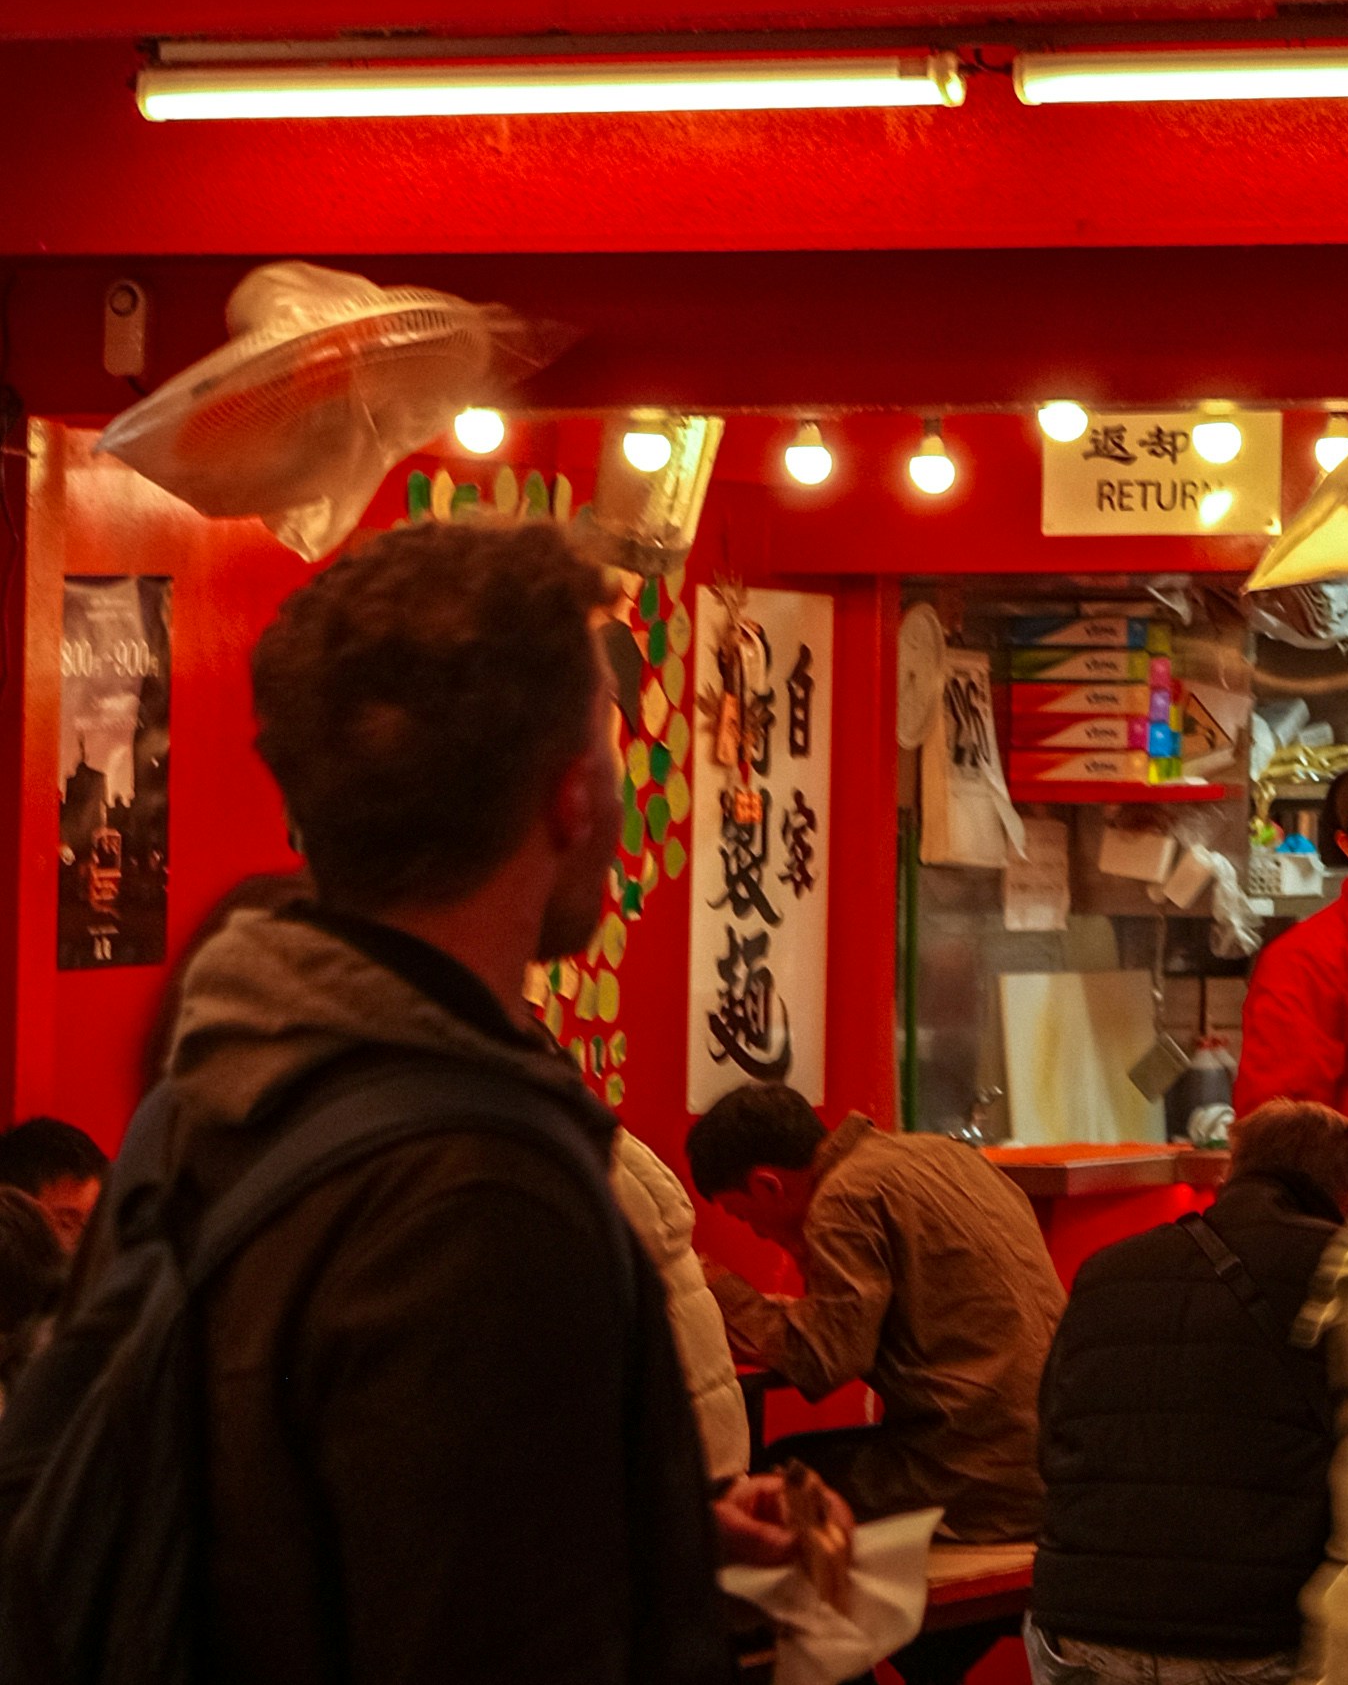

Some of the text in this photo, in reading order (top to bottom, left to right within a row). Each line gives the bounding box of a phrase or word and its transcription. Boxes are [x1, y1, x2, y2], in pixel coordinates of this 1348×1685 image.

[1082, 423, 1191, 466] 返却
[1096, 478, 1226, 512] RETUR
[777, 640, 816, 900] 自家
